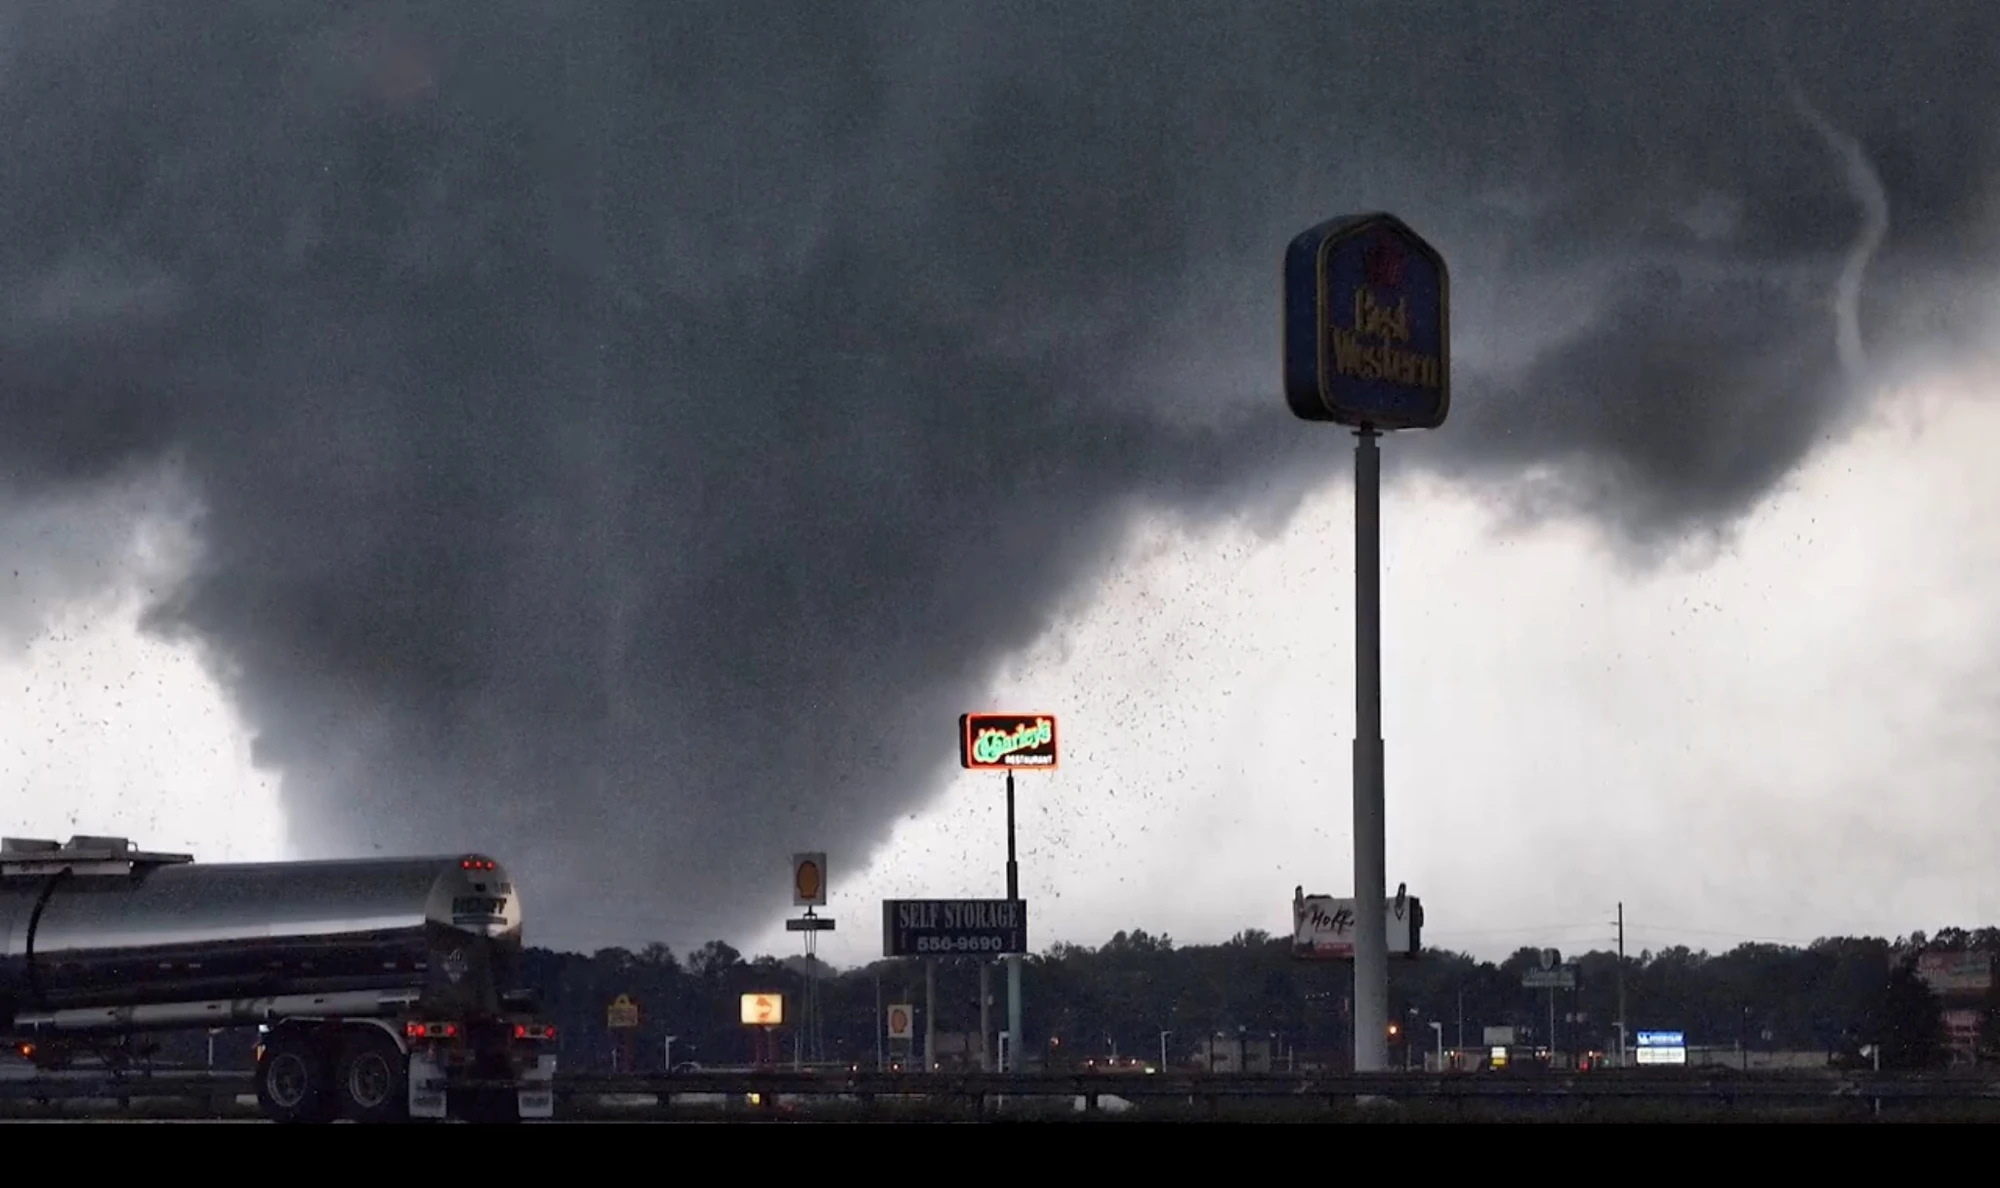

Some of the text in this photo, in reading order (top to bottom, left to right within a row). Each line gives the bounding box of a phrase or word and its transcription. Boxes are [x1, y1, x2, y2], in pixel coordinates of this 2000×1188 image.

[1354, 286, 1409, 342] Best
[1332, 326, 1438, 386] Western
[900, 902, 1018, 929] SELF STORAGE
[917, 935, 1003, 951] 556-9690
